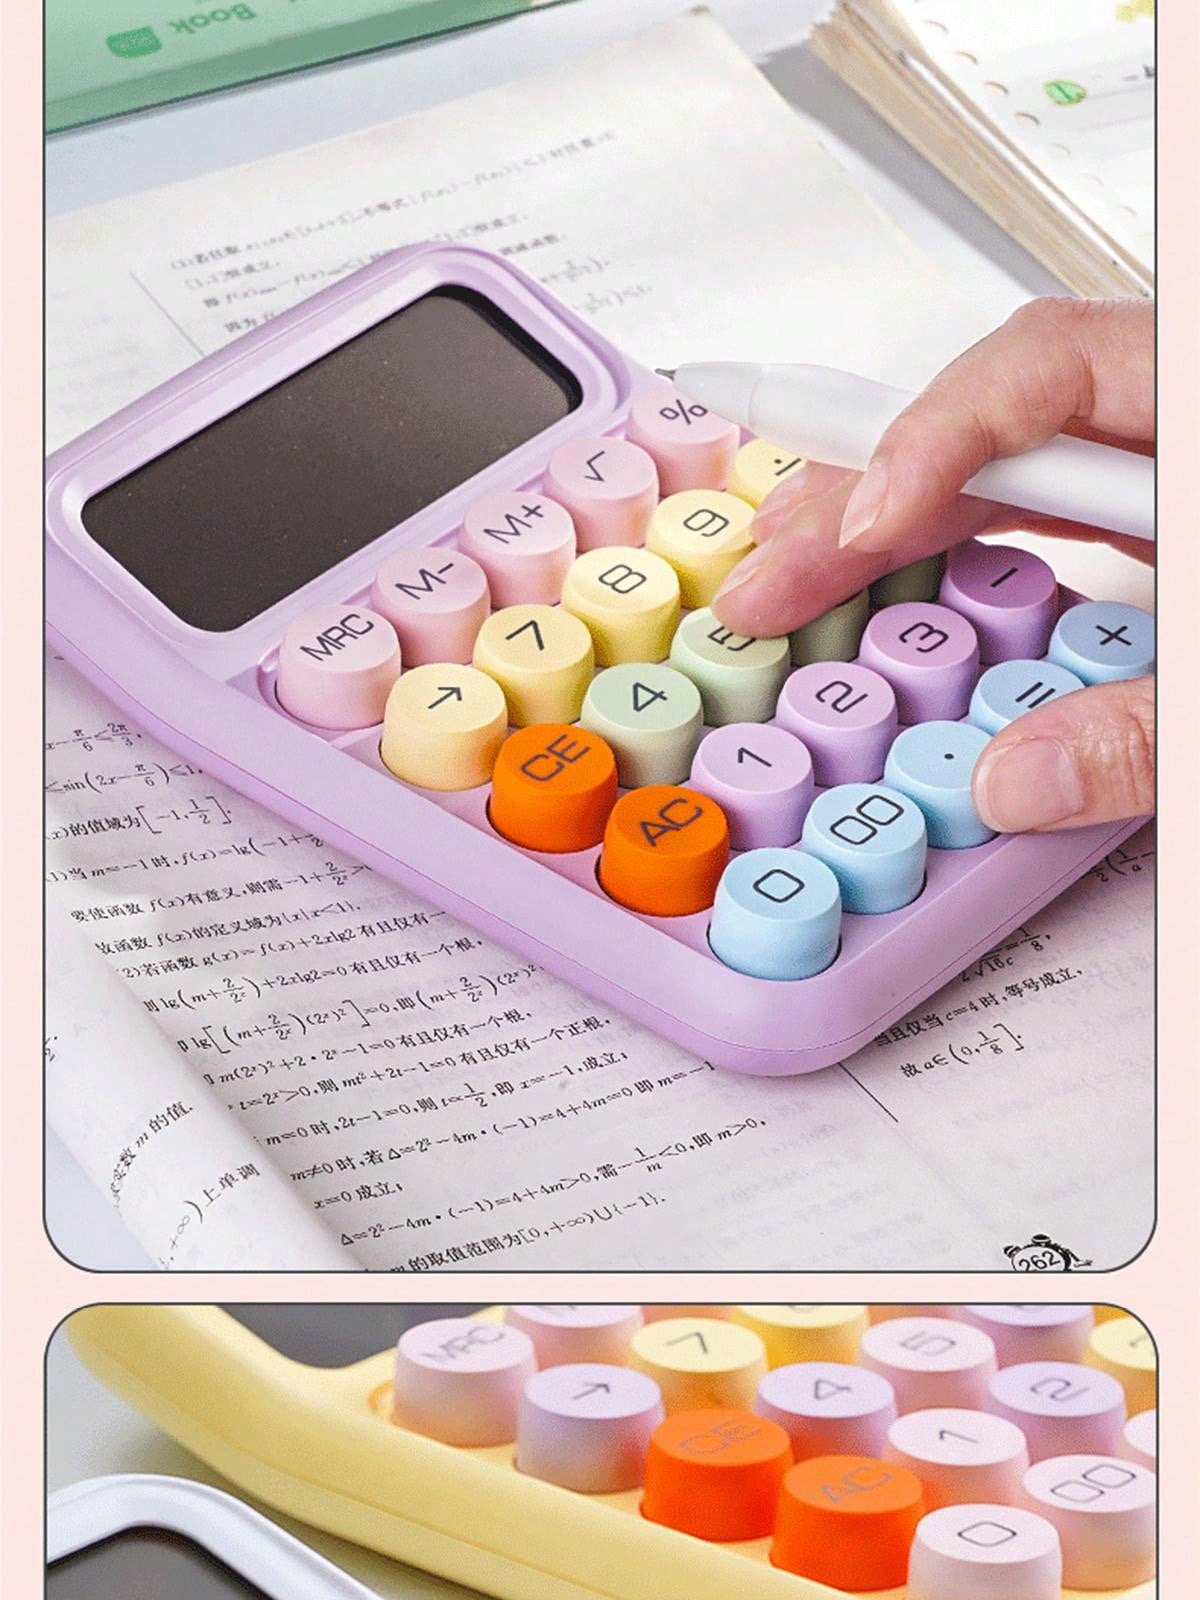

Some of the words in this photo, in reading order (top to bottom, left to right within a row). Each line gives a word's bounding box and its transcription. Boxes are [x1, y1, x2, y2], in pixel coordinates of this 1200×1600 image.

[483, 504, 544, 544] M+
[684, 508, 729, 538] 9
[395, 563, 454, 600] M-
[598, 563, 647, 594] 8
[300, 613, 374, 661] MRC
[506, 620, 545, 651] 7
[899, 621, 948, 653] 3
[632, 681, 668, 713] 4
[815, 680, 869, 714] 2
[520, 733, 591, 783] CE
[737, 747, 773, 769] 1
[640, 798, 704, 847] AC
[830, 794, 904, 845] 00
[752, 868, 805, 903] 0
[665, 1331, 708, 1354] 7
[813, 1378, 852, 1400] 4
[1029, 1377, 1090, 1402] 2
[939, 1429, 978, 1444] 1
[1050, 1463, 1137, 1502] 00
[957, 1521, 1017, 1547] 0
